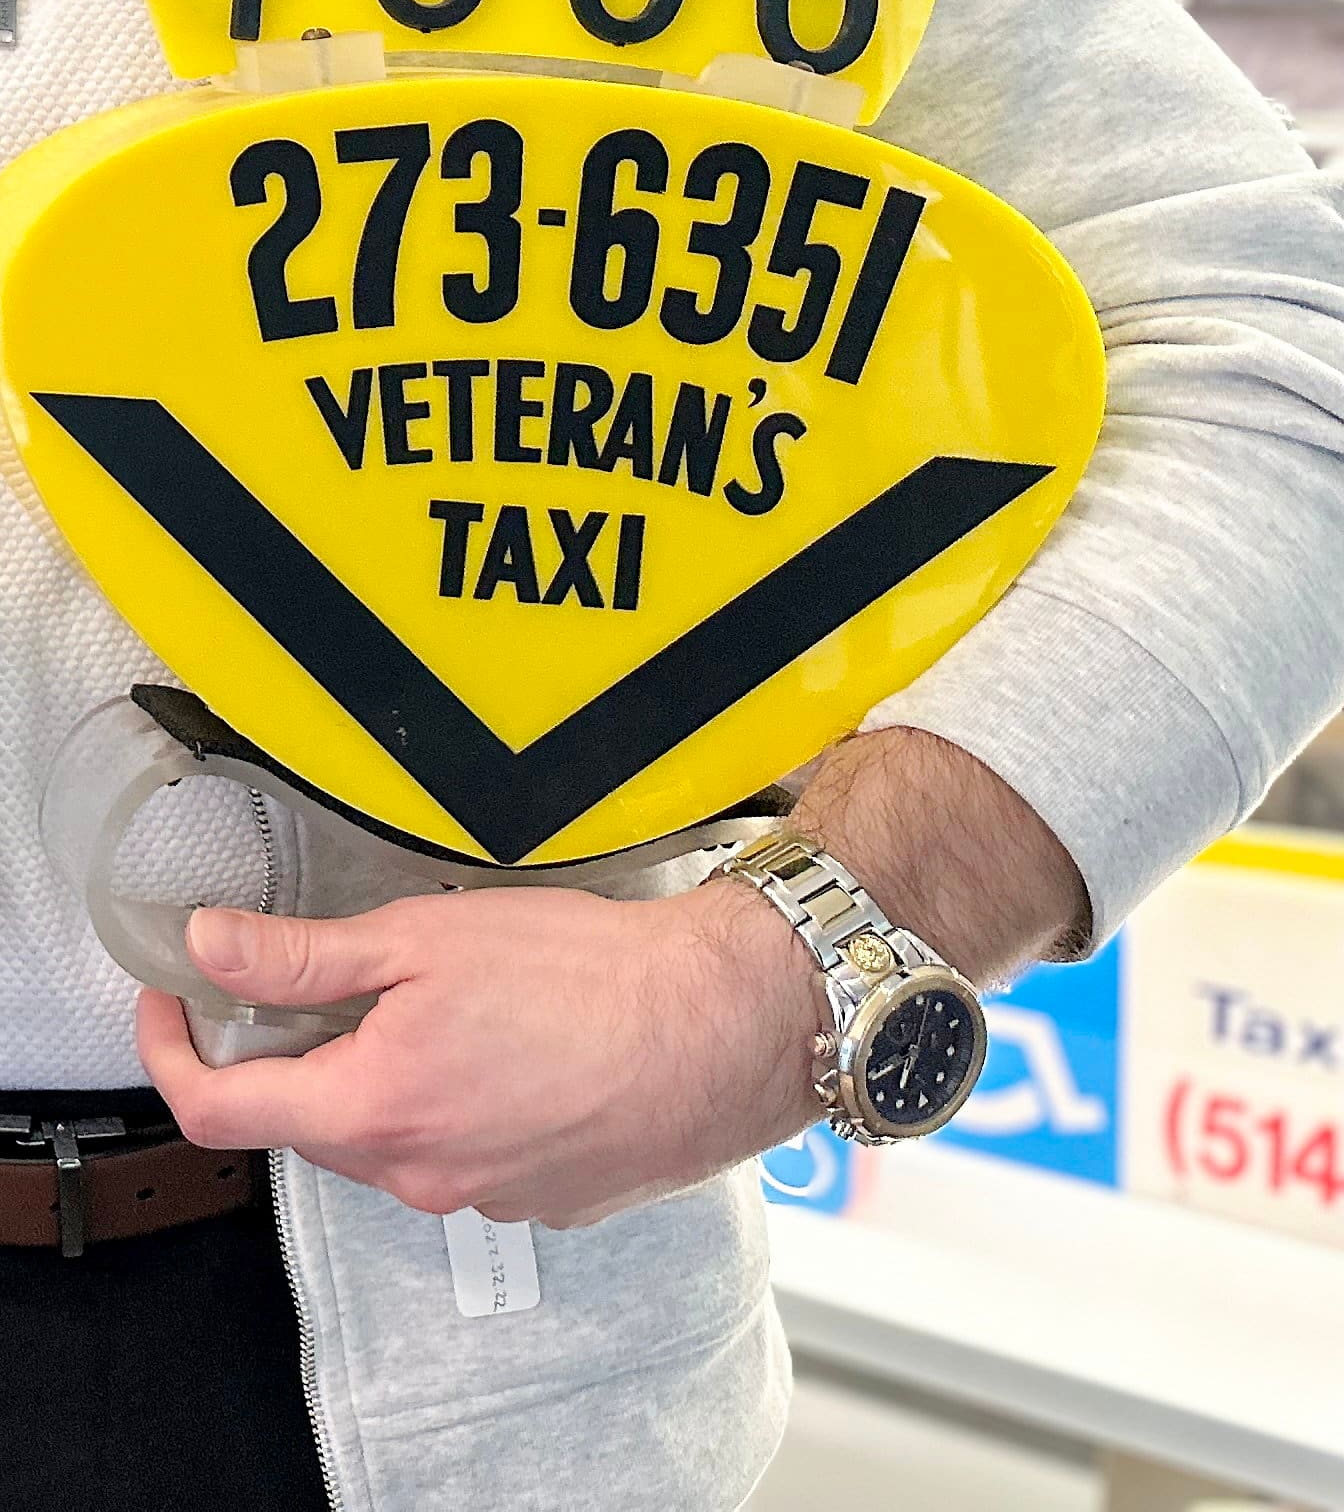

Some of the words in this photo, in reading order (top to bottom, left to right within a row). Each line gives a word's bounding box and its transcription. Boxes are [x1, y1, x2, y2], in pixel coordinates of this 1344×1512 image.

[229, 119, 928, 385] 273-6351
[304, 359, 807, 516] VETERAN'S
[428, 499, 646, 611] TAXI
[1163, 1075, 1344, 1206] (514
